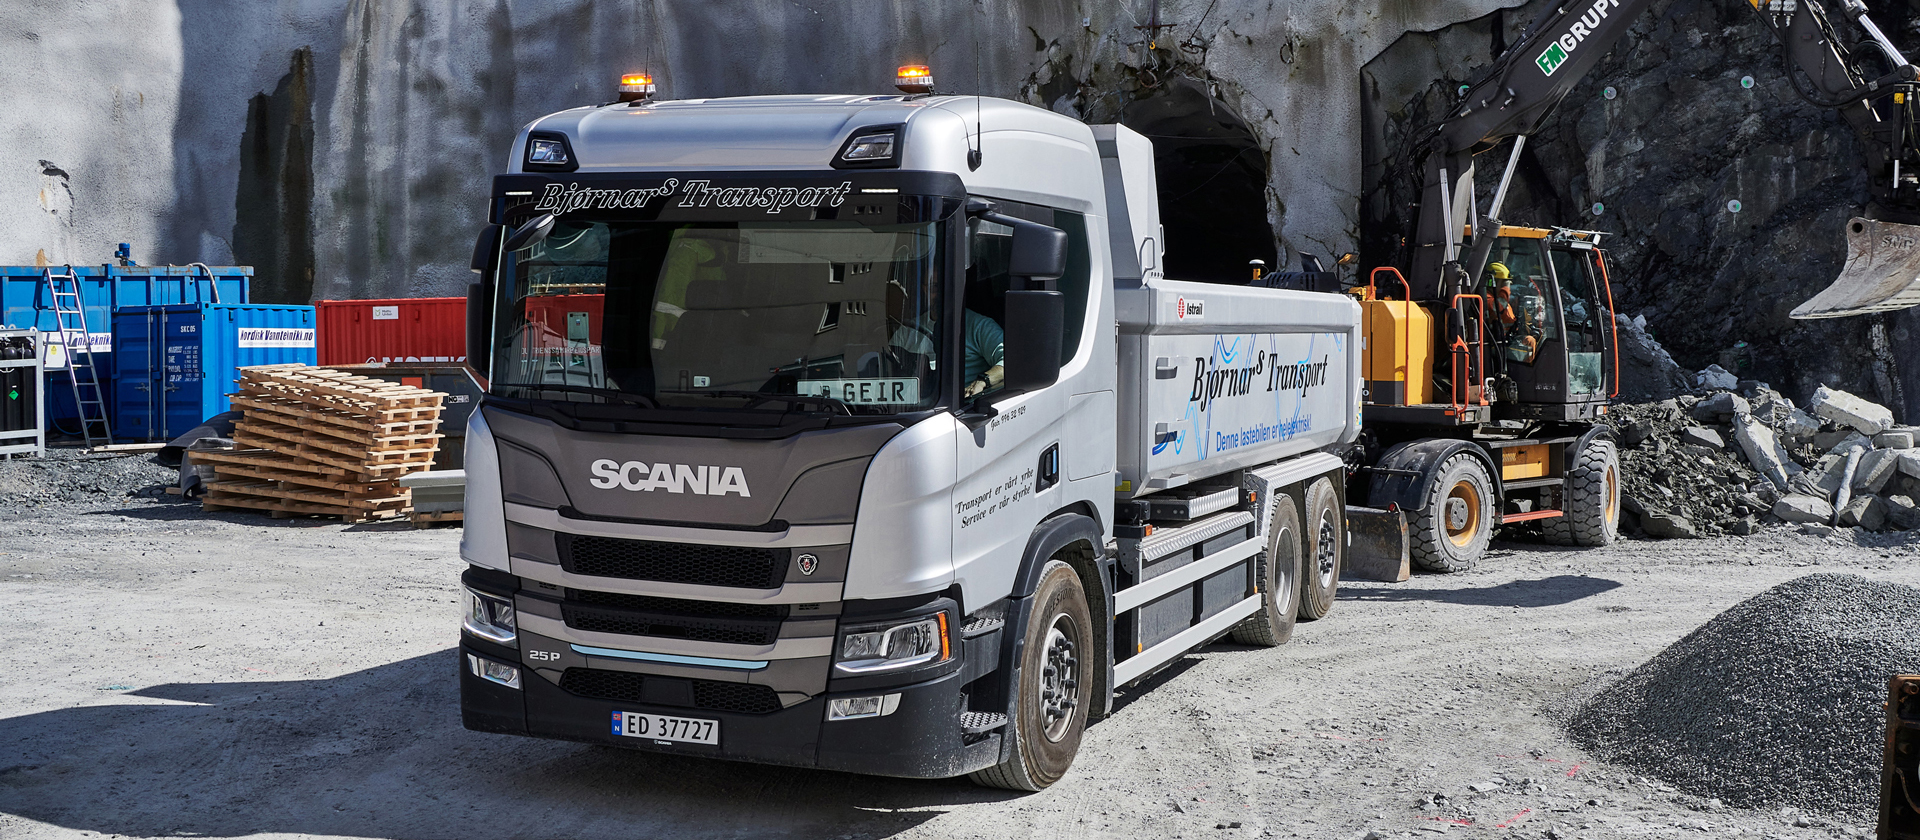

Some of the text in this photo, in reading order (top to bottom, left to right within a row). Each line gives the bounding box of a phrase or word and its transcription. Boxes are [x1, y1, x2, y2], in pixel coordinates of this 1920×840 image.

[1536, 42, 1567, 75] FM
[678, 179, 851, 213] Transport
[1266, 354, 1328, 398] Transport
[842, 381, 905, 403] GEIR
[1216, 431, 1239, 452] Denne
[1240, 422, 1271, 447] lastebilen
[1272, 424, 1279, 439] er
[589, 458, 752, 498] SCANIA
[994, 485, 1002, 496] er
[961, 509, 987, 529] Service
[988, 504, 997, 515] er
[627, 714, 714, 741] ED 37727
